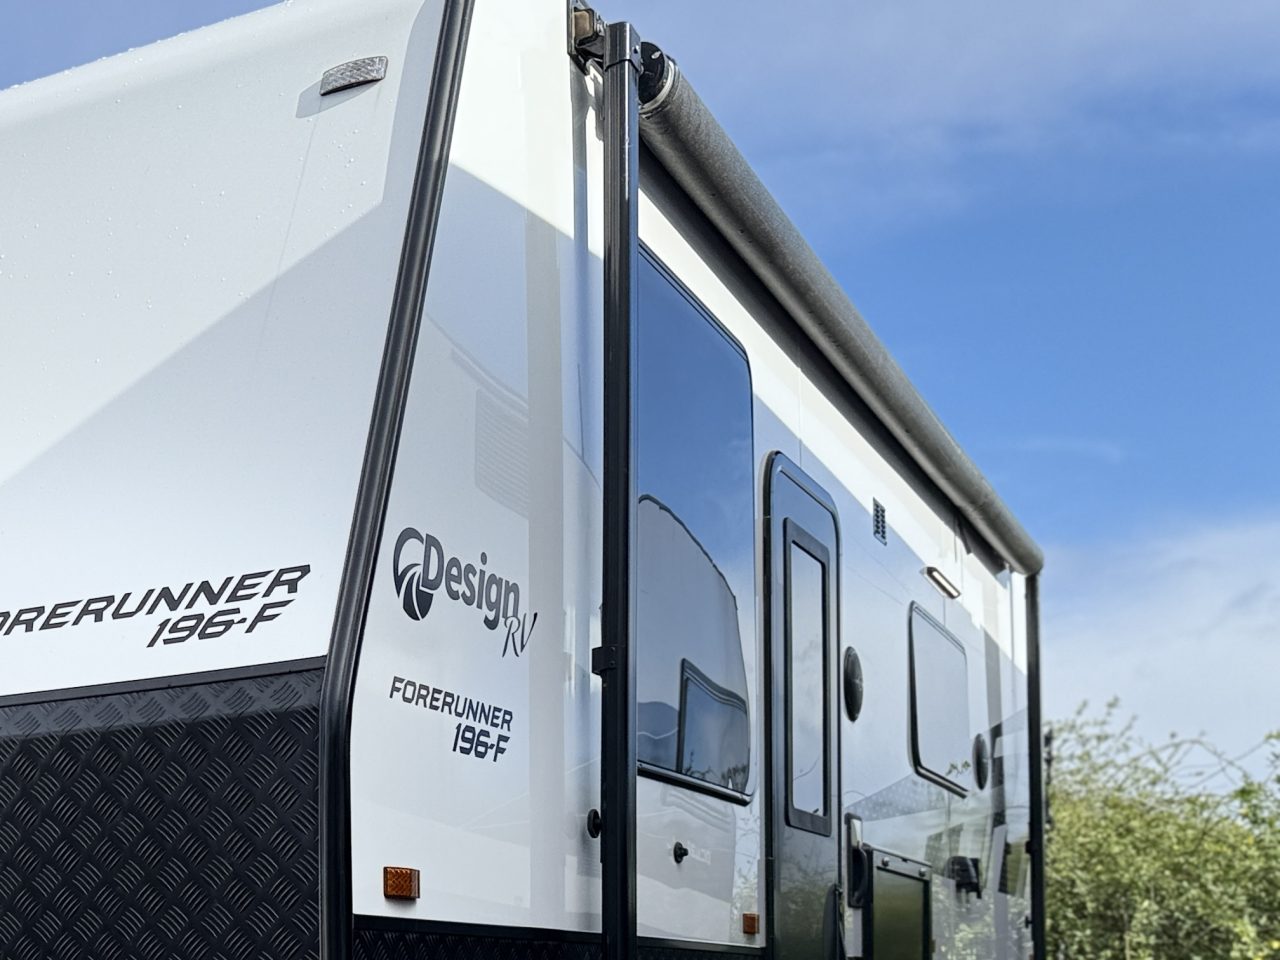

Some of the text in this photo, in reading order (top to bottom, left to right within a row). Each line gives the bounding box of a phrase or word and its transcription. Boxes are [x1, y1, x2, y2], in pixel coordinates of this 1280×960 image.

[421, 534, 520, 630] Design
[148, 599, 295, 648] 196-F
[389, 676, 514, 731] FORERUNNER
[452, 723, 510, 762] 196-F
